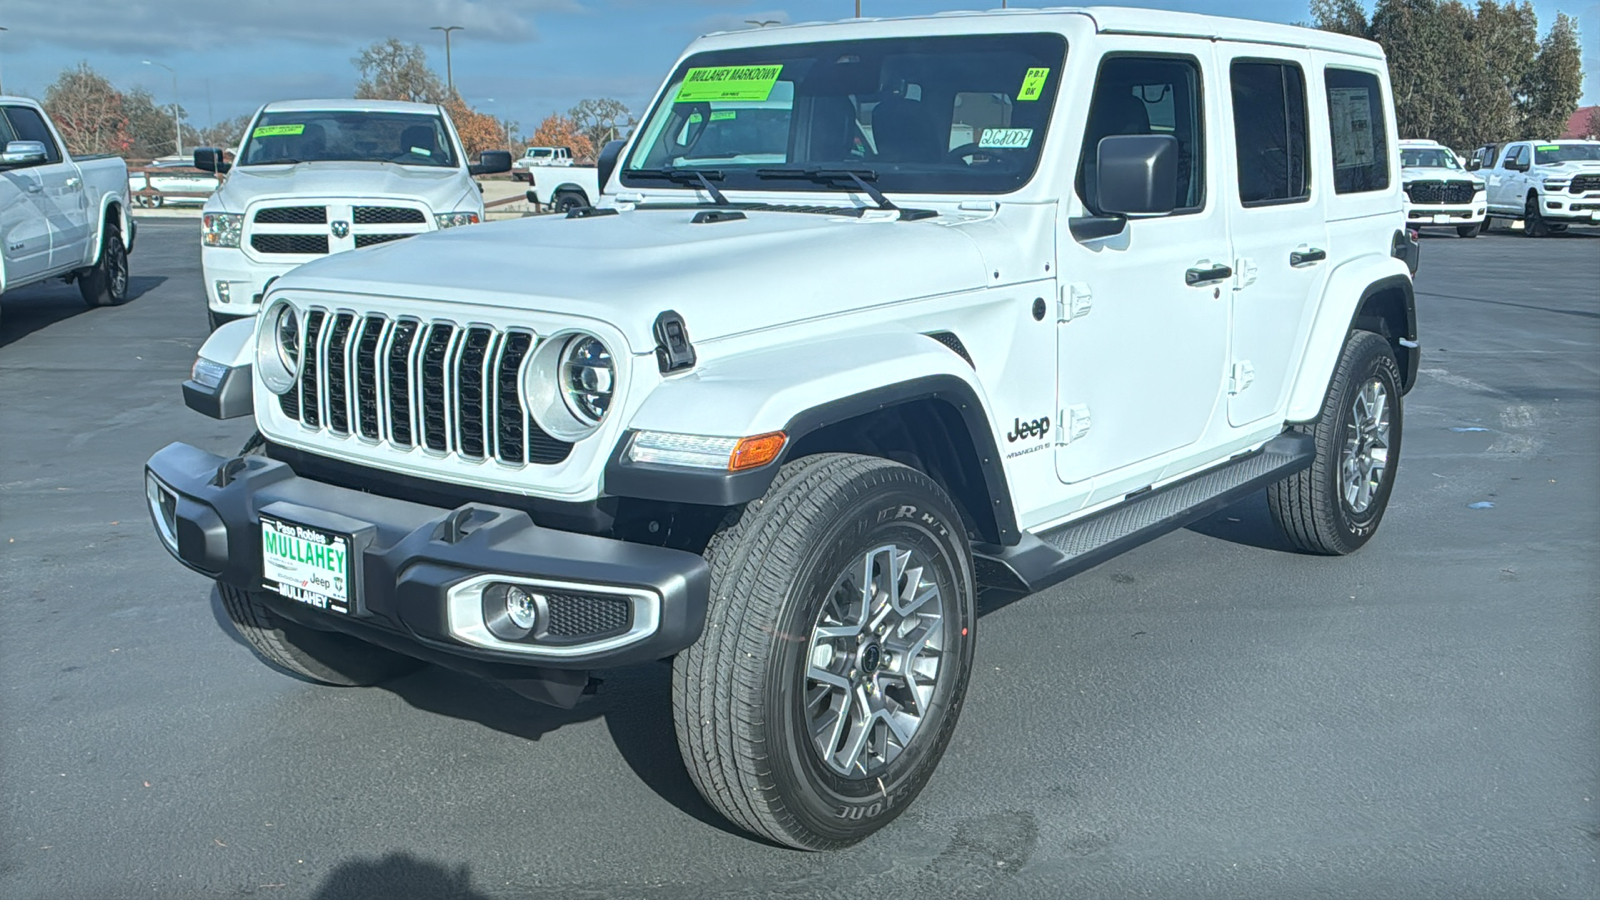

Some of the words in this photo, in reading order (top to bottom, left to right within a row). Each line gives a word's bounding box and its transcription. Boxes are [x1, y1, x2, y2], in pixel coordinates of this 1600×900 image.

[689, 68, 731, 82] MULLAHEY
[729, 67, 779, 81] MARKDOWN
[1025, 87, 1036, 96] OK
[1007, 416, 1051, 443] Jeep
[276, 521, 296, 537] Paso
[296, 526, 326, 544] Robles
[264, 530, 344, 574] MULLAHEY
[310, 573, 330, 590] Jeep
[279, 583, 328, 609] MULLAHEY
